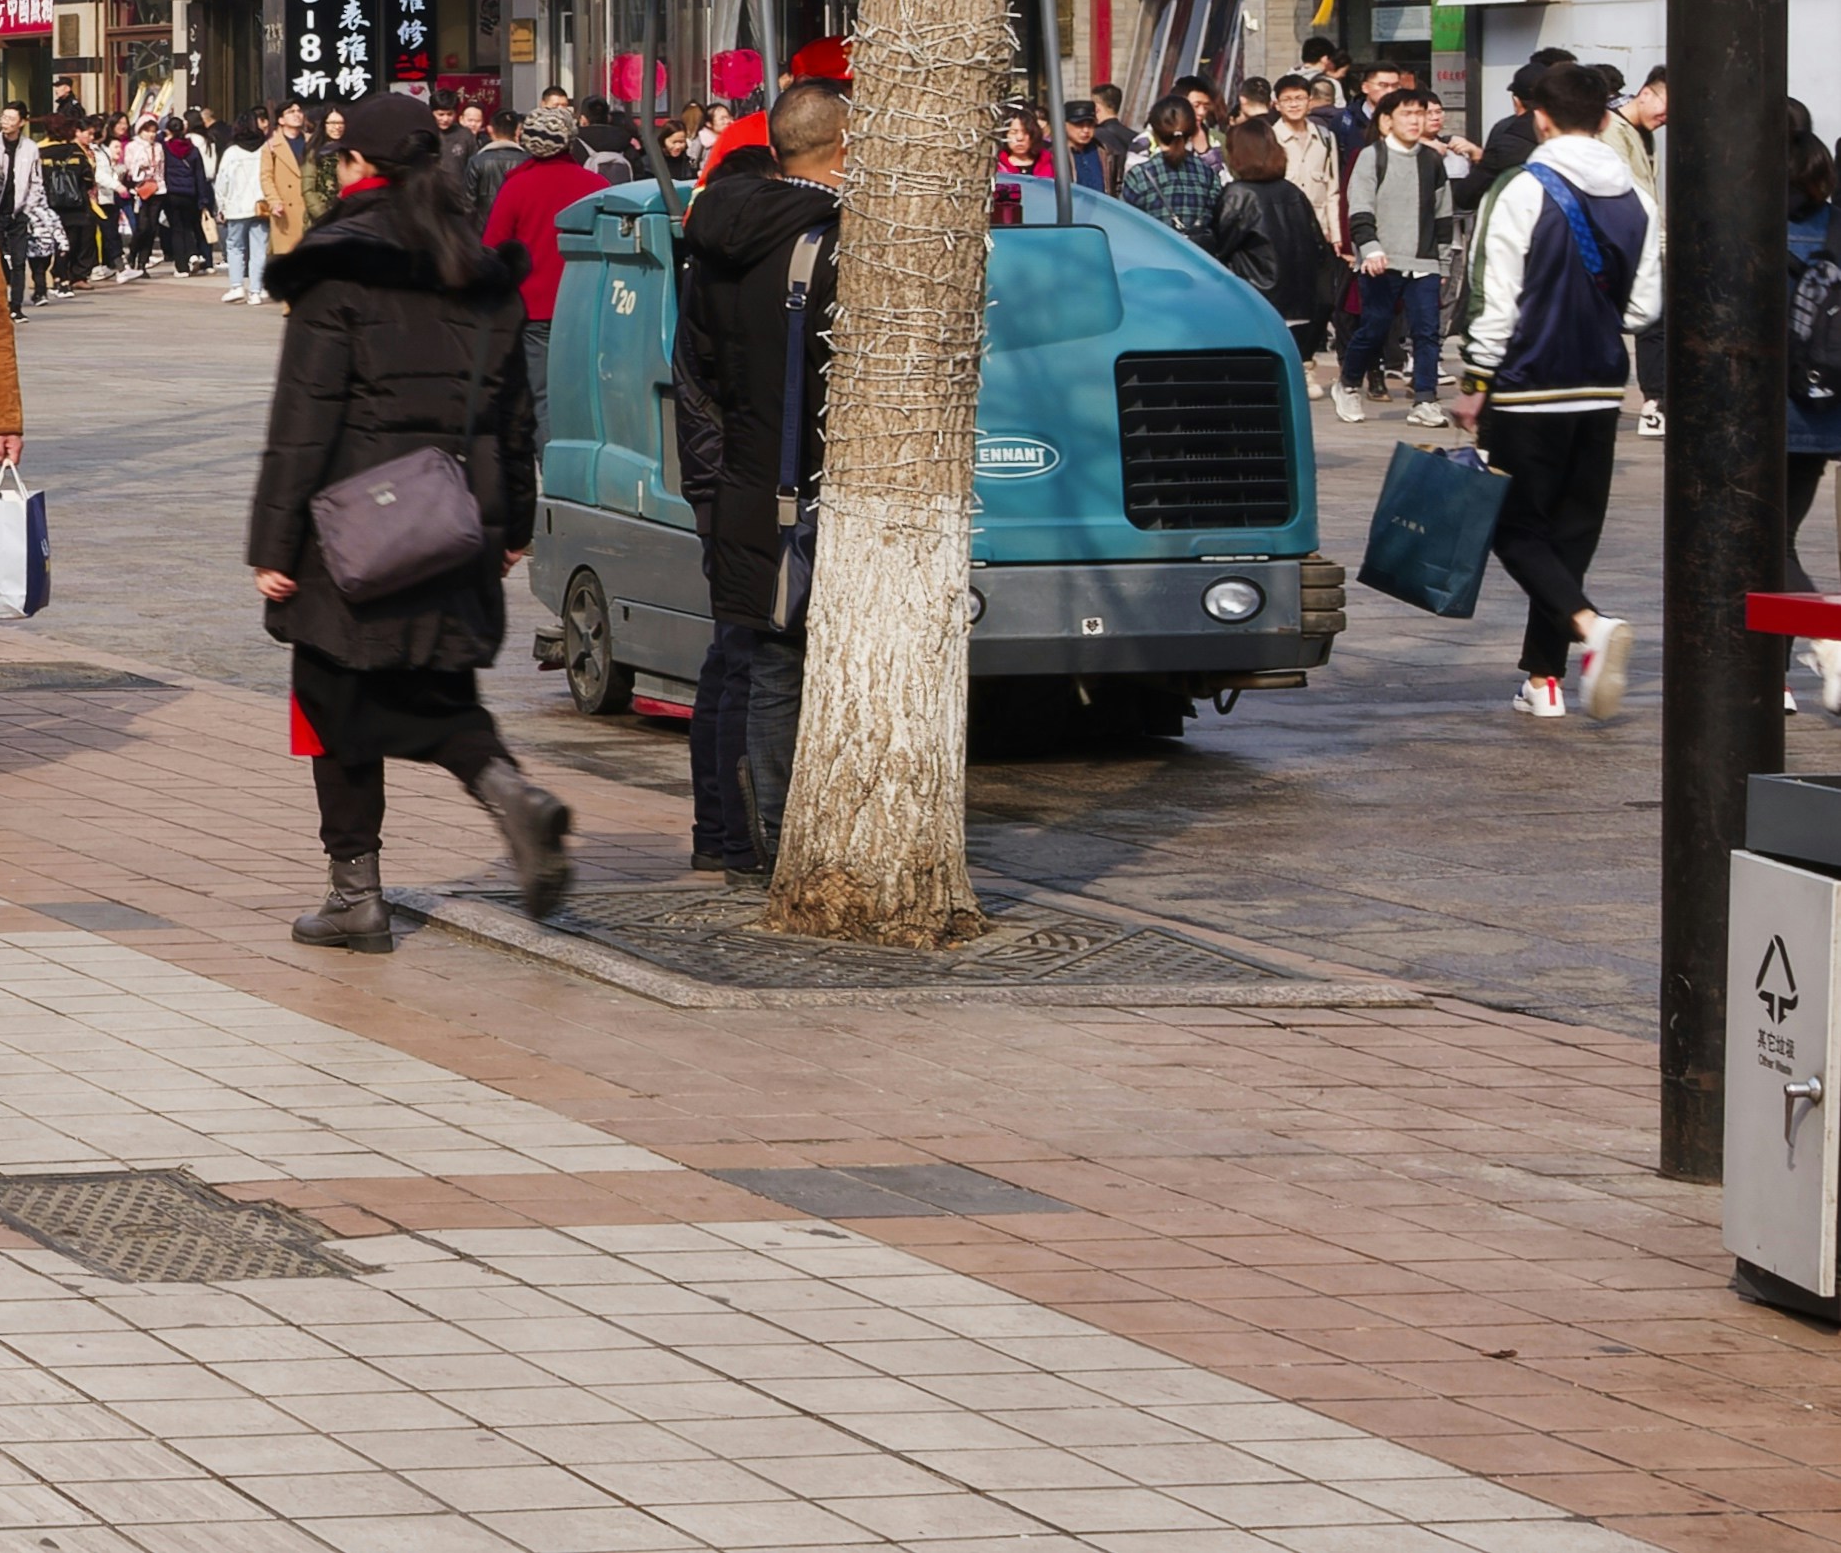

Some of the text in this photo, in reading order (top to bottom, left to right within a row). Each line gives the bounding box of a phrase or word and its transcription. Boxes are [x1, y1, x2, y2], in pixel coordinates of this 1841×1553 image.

[611, 280, 637, 315] T20
[976, 447, 1046, 467] ENNANT
[1757, 1028, 1796, 1060] 其它垃圾
[1758, 1053, 1774, 1069] Other
